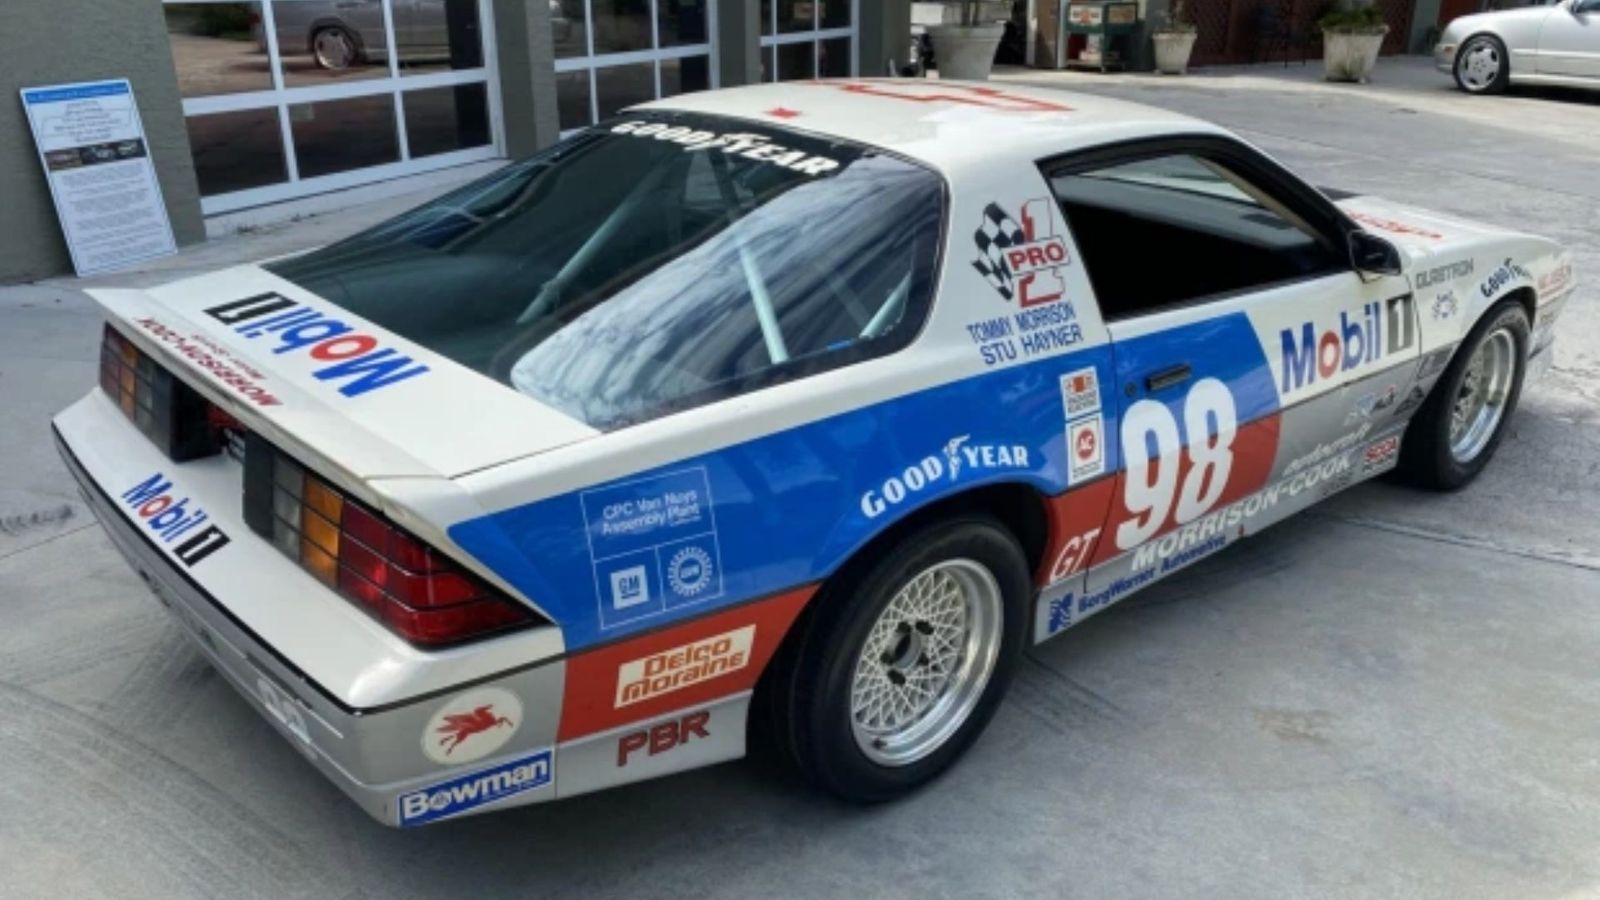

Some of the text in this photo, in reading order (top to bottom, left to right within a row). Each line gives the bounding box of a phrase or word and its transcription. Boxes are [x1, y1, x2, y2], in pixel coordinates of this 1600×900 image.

[1007, 242, 1065, 270] PRO
[967, 302, 1077, 344] TOMMY MORRISON
[980, 323, 1085, 366] STU HAYNER
[1279, 296, 1409, 394] Mobil 1
[234, 306, 430, 398] Mobil
[1116, 377, 1238, 551] 98
[121, 472, 208, 543] Mobil
[602, 489, 698, 520] CPC Van Nuys
[602, 501, 700, 536] Assembly Plant
[1131, 455, 1350, 572] MORRISON-COOK
[1049, 526, 1102, 583] GT
[617, 574, 642, 599] GM
[1077, 567, 1158, 613] BorgWarner
[620, 650, 746, 700] Moraine
[642, 637, 733, 678] Delco
[616, 710, 711, 768] PBR
[403, 759, 548, 820] Bowman
